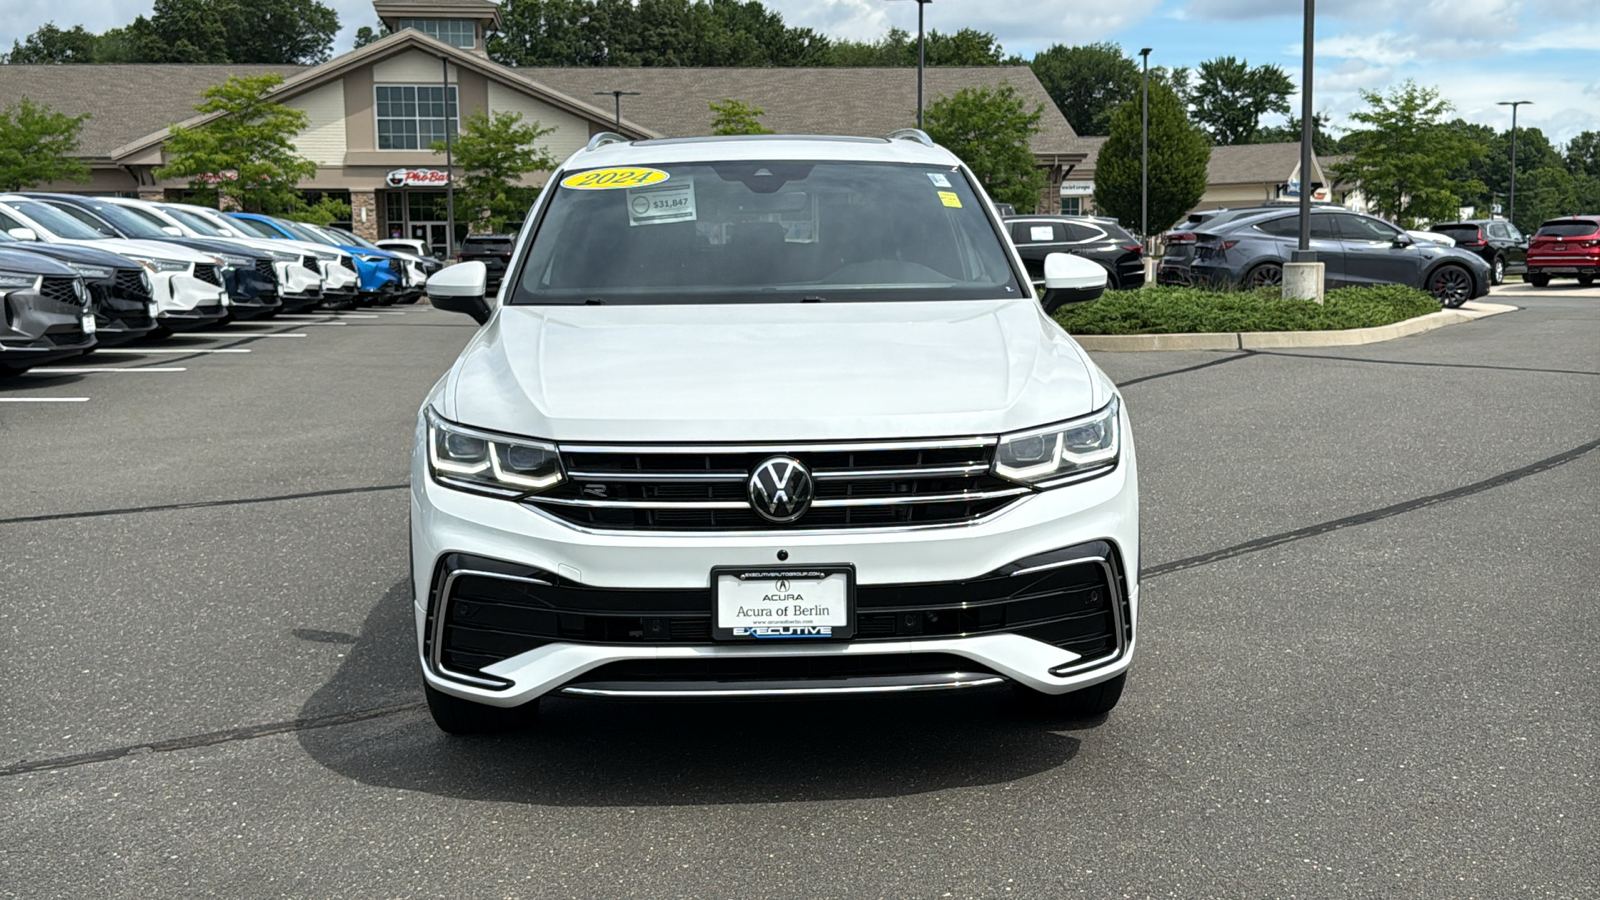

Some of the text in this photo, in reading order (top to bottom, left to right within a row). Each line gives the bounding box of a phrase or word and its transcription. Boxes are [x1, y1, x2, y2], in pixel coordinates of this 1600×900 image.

[576, 171, 653, 186] 2024
[653, 197, 689, 209] $31,847
[762, 593, 804, 602] ACURA
[736, 604, 830, 618] Acura of Berlin
[733, 627, 832, 636] EXECUTIVE
